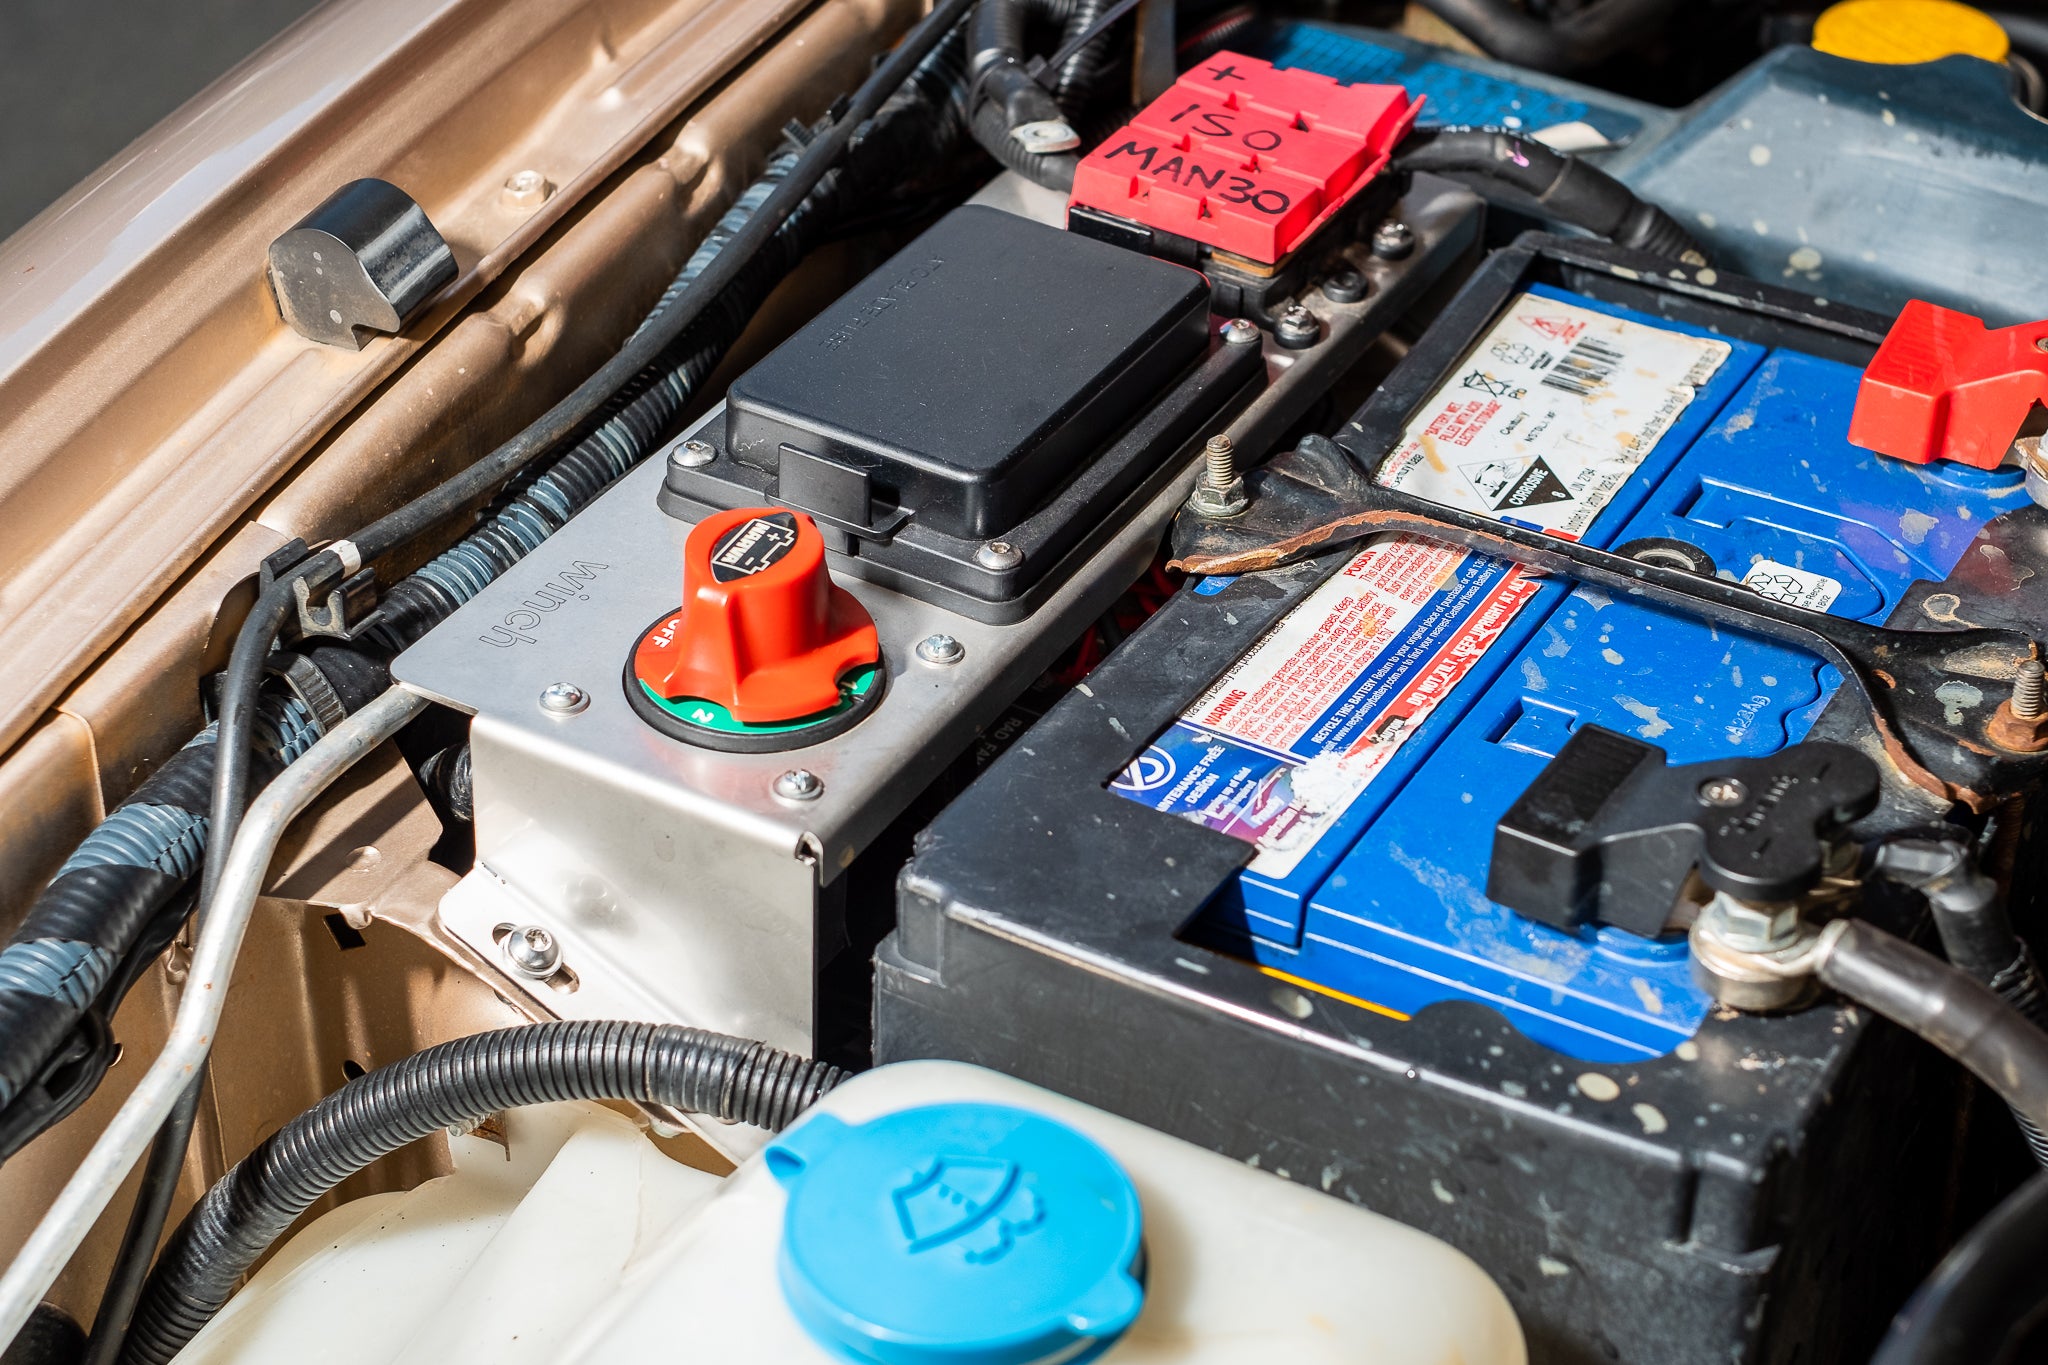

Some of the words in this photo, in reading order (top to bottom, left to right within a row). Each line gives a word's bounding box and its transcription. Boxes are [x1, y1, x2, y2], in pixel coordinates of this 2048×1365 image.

[1104, 141, 1291, 215] MAN30
[1505, 467, 1551, 506] CORROSIVE
[1549, 489, 1567, 498] 8
[1567, 481, 1587, 492] UN
[721, 522, 770, 564] NARVA
[1342, 549, 1377, 578] POISON
[1357, 568, 1379, 582] This
[1368, 550, 1398, 572] battery
[1370, 574, 1392, 589] acid
[1381, 554, 1411, 577] contacts
[1393, 551, 1433, 582] immediately
[1396, 583, 1419, 600] event
[1414, 560, 1442, 581] contact
[1430, 549, 1451, 562] with
[1461, 567, 1480, 578] call
[1382, 578, 1406, 594] flush
[1458, 576, 1471, 584] or
[1471, 566, 1498, 587] Battery
[1407, 583, 1436, 605] medical
[1437, 582, 1469, 607] purchase
[1495, 590, 1518, 604] AT
[1806, 577, 1828, 601] Recycle
[479, 560, 609, 649] winch
[1431, 604, 1446, 613] of
[1336, 609, 1361, 626] from
[1419, 610, 1443, 627] place
[1426, 617, 1452, 637] nearest
[1465, 601, 1510, 637] UPRIGHT
[1323, 624, 1351, 643] away
[1402, 624, 1430, 645] original
[1417, 636, 1437, 649] your
[1234, 703, 1255, 717] acid
[1245, 679, 1278, 705] batteries
[1269, 656, 1303, 682] generate
[1291, 631, 1326, 659] explosive
[1314, 612, 1345, 634] gases.
[1331, 595, 1357, 614] Keep
[1299, 640, 1335, 668] cigarettes
[1392, 643, 1414, 657] your
[1405, 647, 1425, 659] find
[1448, 634, 1482, 658] KEEP
[1370, 660, 1395, 680] Return
[1386, 655, 1401, 663] to
[1401, 658, 1415, 666] to
[1244, 721, 1270, 740] When
[1261, 697, 1297, 724] charging
[1292, 675, 1318, 693] using
[1305, 657, 1335, 678] battery
[1336, 618, 1370, 645] enclosed
[1258, 721, 1289, 745] provide
[1304, 678, 1329, 696] Avoid
[1321, 658, 1350, 681] contact
[1345, 637, 1369, 654] metal
[1377, 605, 1399, 619] with
[1279, 665, 1311, 687] lighted
[1296, 692, 1334, 722] Maximum
[1325, 668, 1359, 695] recharge
[1347, 648, 1378, 670] voltage
[1415, 674, 1445, 694] NOT
[1270, 683, 1290, 697] and
[1346, 677, 1380, 705] BATTERY
[1404, 690, 1429, 706] DO
[1201, 688, 1247, 726] WARNING
[1327, 663, 1413, 742] www.recyclemybattery.com.au
[1333, 702, 1356, 718] THIS
[691, 708, 714, 723] 2
[994, 717, 1024, 742] RAD
[1309, 715, 1344, 744] RECYCLE
[1154, 764, 1207, 811] INTENANCE
[1198, 744, 1227, 766] FREE
[1182, 772, 1221, 804] DESIGN
